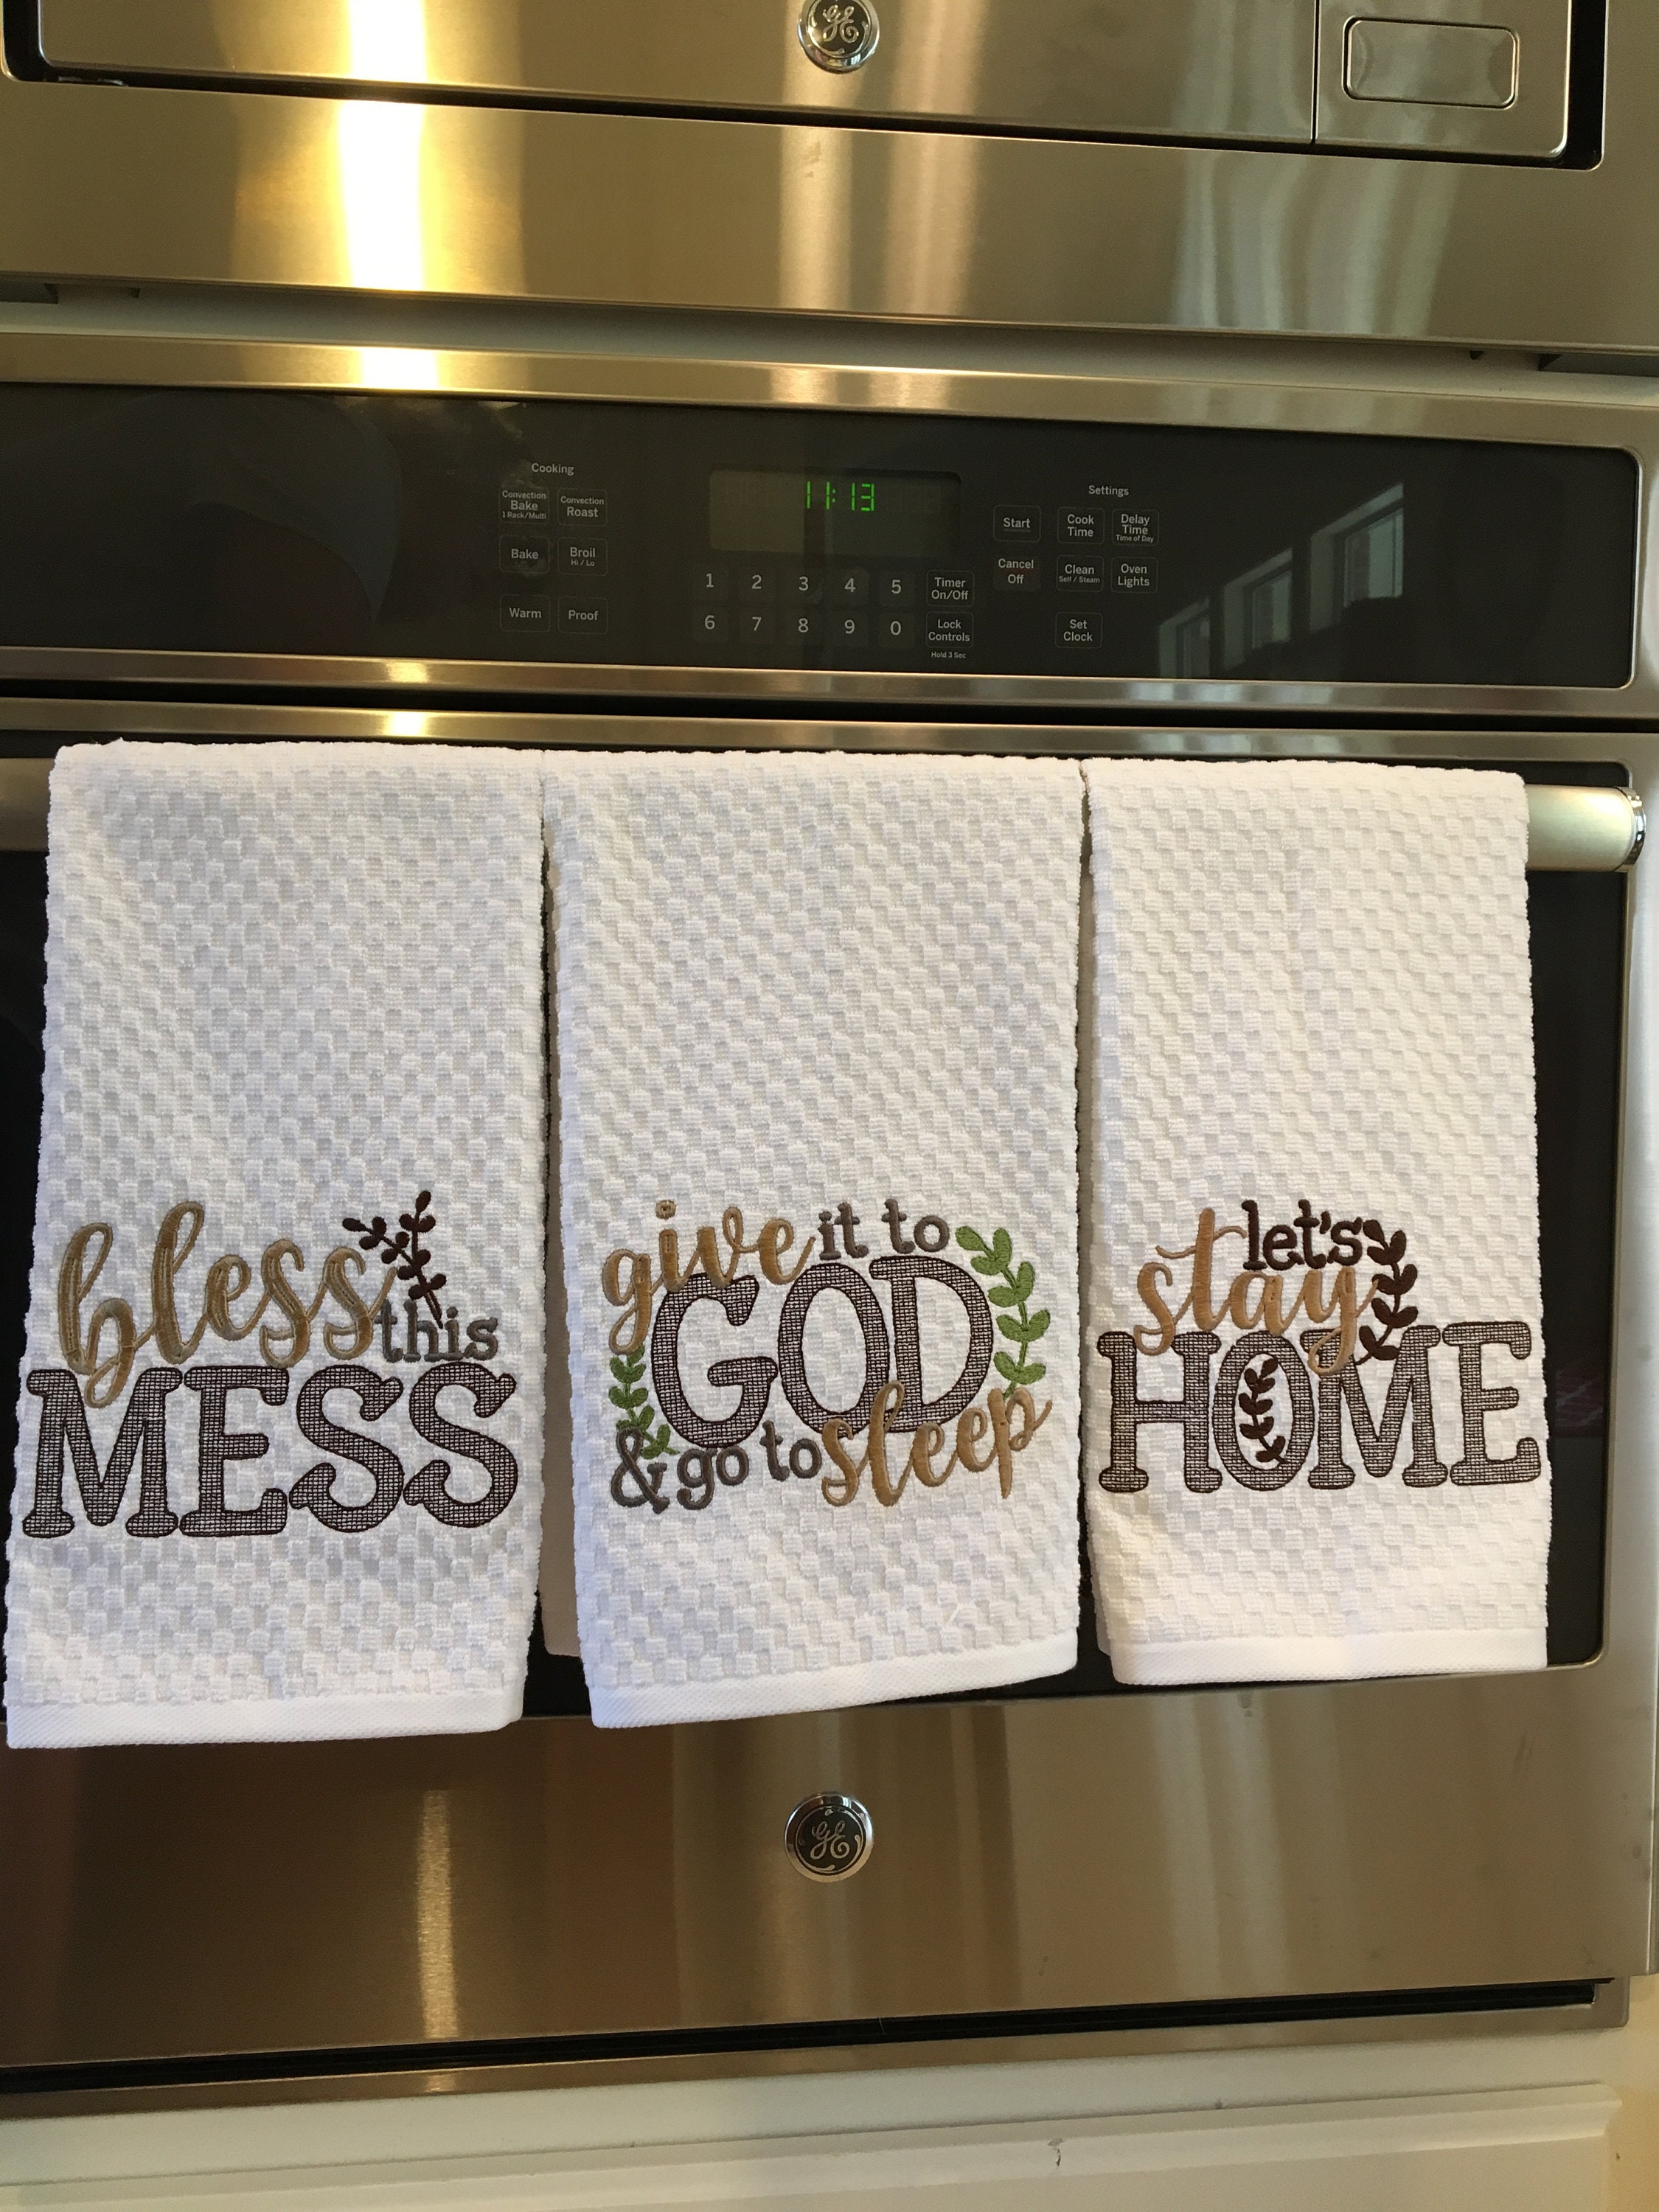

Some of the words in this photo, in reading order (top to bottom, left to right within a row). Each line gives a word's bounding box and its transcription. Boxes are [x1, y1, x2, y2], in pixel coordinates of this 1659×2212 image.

[531, 462, 574, 476] Cooking
[501, 490, 547, 499] Convection
[807, 481, 875, 512] 11:13
[1088, 484, 1130, 498] Settings
[510, 499, 539, 511] Bake
[560, 495, 605, 505] Convection
[507, 511, 547, 520] Rack/Multi
[566, 506, 599, 518] Roast
[1003, 517, 1031, 529] Start
[1067, 513, 1095, 525] Cook
[1121, 513, 1151, 526] Delay
[1067, 526, 1094, 538] Time
[1121, 524, 1149, 535] Time
[1116, 534, 1133, 542] Time
[1141, 535, 1155, 543] Day
[511, 548, 539, 560] Bake
[569, 546, 596, 558] Broil
[998, 557, 1034, 570] Cancel
[1065, 563, 1095, 575] Clean
[1120, 563, 1148, 574] Oven
[705, 573, 714, 588] 1
[751, 574, 762, 589] 2
[799, 576, 809, 591] 3
[844, 577, 856, 593] 4
[891, 579, 902, 594] 5
[934, 577, 967, 588] Timer
[1007, 573, 1025, 585] Off
[1058, 575, 1072, 583] Self
[1079, 576, 1101, 584] Steam
[1117, 575, 1150, 588] Lights
[931, 589, 970, 601] On/Off
[509, 606, 543, 619] Warm
[568, 609, 599, 621] Proof
[703, 616, 715, 630] 6
[751, 617, 762, 632] 7
[797, 618, 809, 633] 8
[843, 620, 855, 635] 9
[889, 622, 902, 636] 0
[937, 619, 961, 630] Lock
[1069, 619, 1088, 630] Set
[928, 631, 971, 642] Controls
[1063, 631, 1093, 642] Clock
[953, 651, 967, 659] Sec
[1240, 1200, 1363, 1271] let's
[601, 1200, 816, 1354] give
[816, 1202, 869, 1262] it
[880, 1198, 950, 1254] to
[1133, 1208, 1380, 1377] stay
[57, 1200, 400, 1409] bless
[375, 1297, 500, 1364] this
[650, 1255, 994, 1449] GOD
[1096, 1321, 1542, 1494] HOME
[21, 1361, 519, 1538] MESS
[609, 1426, 669, 1514] &
[675, 1447, 750, 1511] go
[759, 1420, 823, 1482] to
[821, 1380, 1053, 1509] sleep
